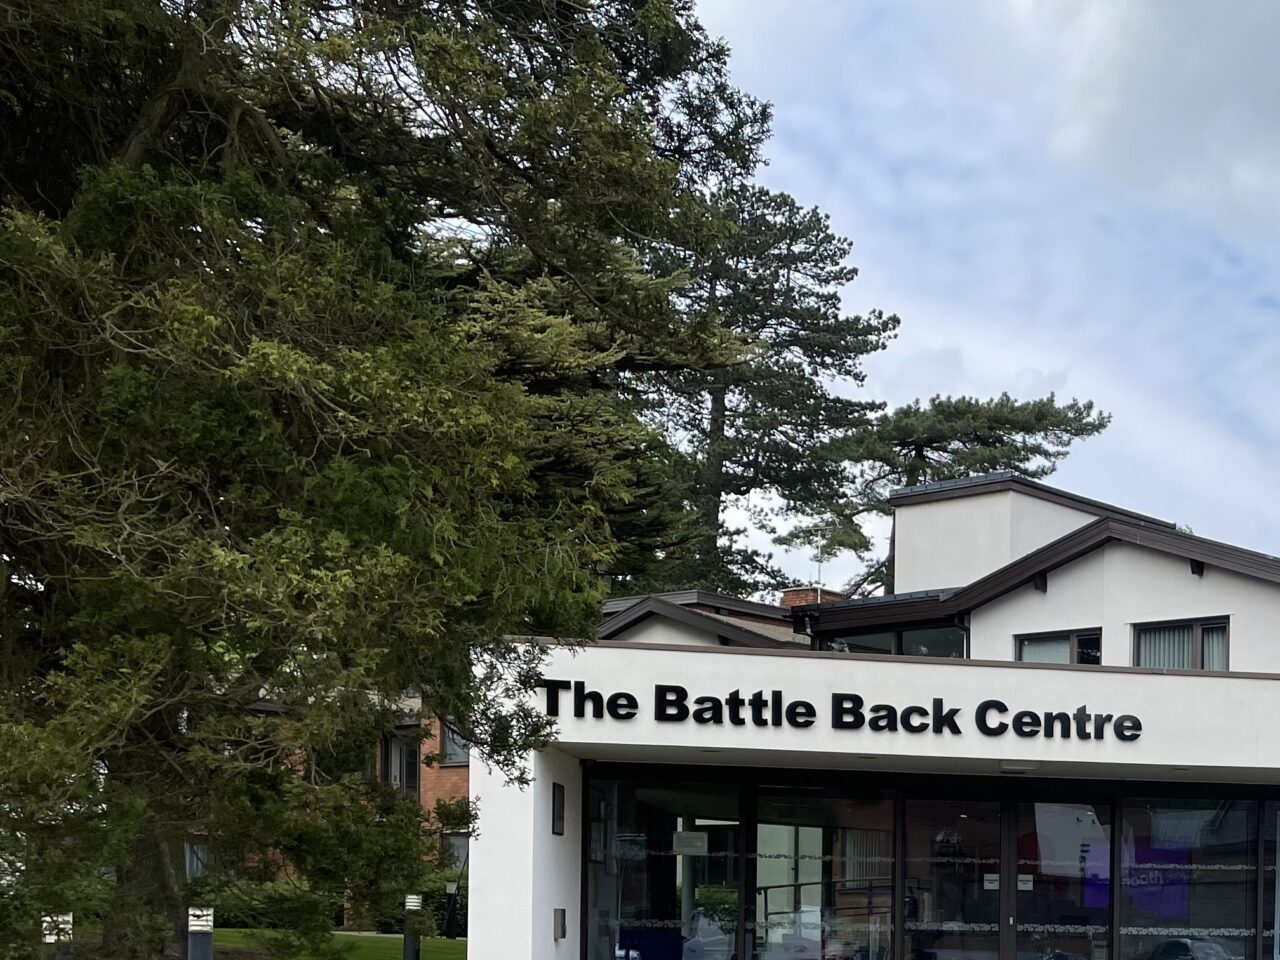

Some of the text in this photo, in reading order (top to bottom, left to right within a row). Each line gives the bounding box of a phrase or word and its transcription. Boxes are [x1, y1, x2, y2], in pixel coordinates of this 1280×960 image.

[541, 679, 1143, 742] The Battle Back Centre
